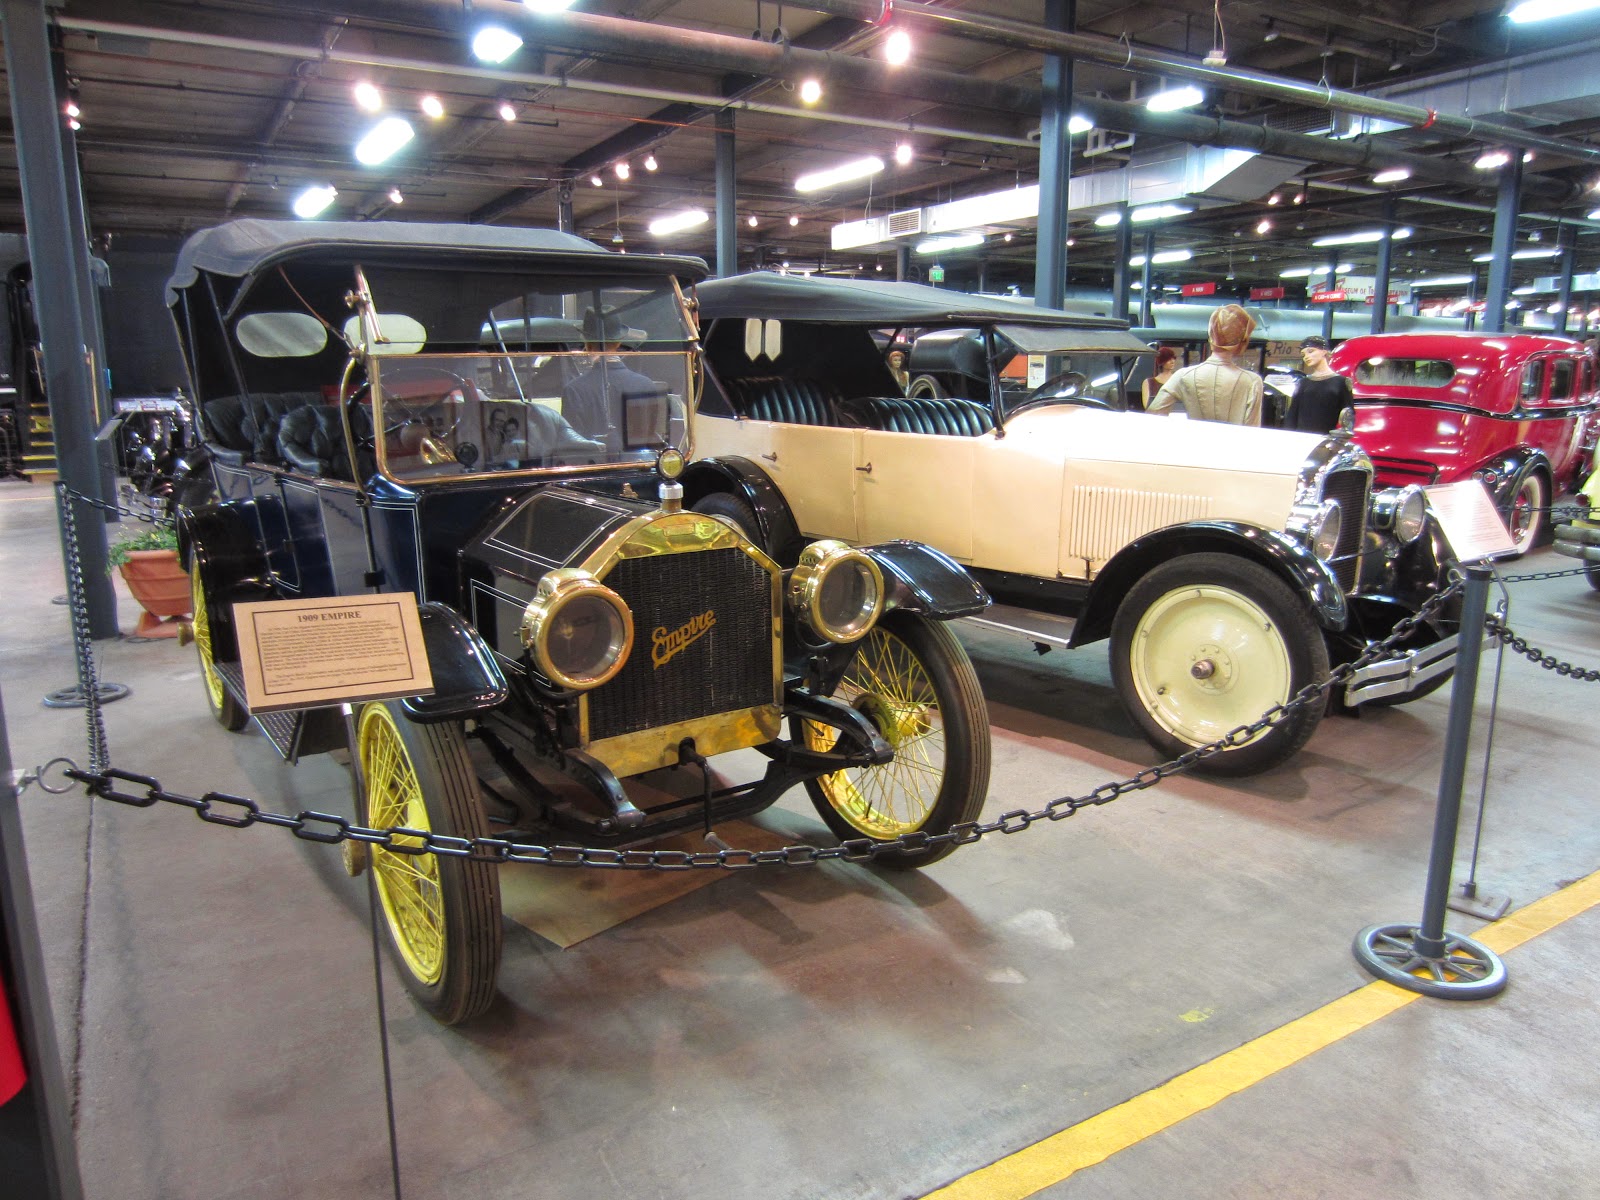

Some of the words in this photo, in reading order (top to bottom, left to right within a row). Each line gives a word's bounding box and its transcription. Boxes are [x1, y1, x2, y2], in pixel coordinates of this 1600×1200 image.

[1273, 341, 1292, 355] Rio
[298, 613, 319, 623] 1909
[321, 611, 362, 622] EMPIRE
[651, 609, 717, 670] Empire
